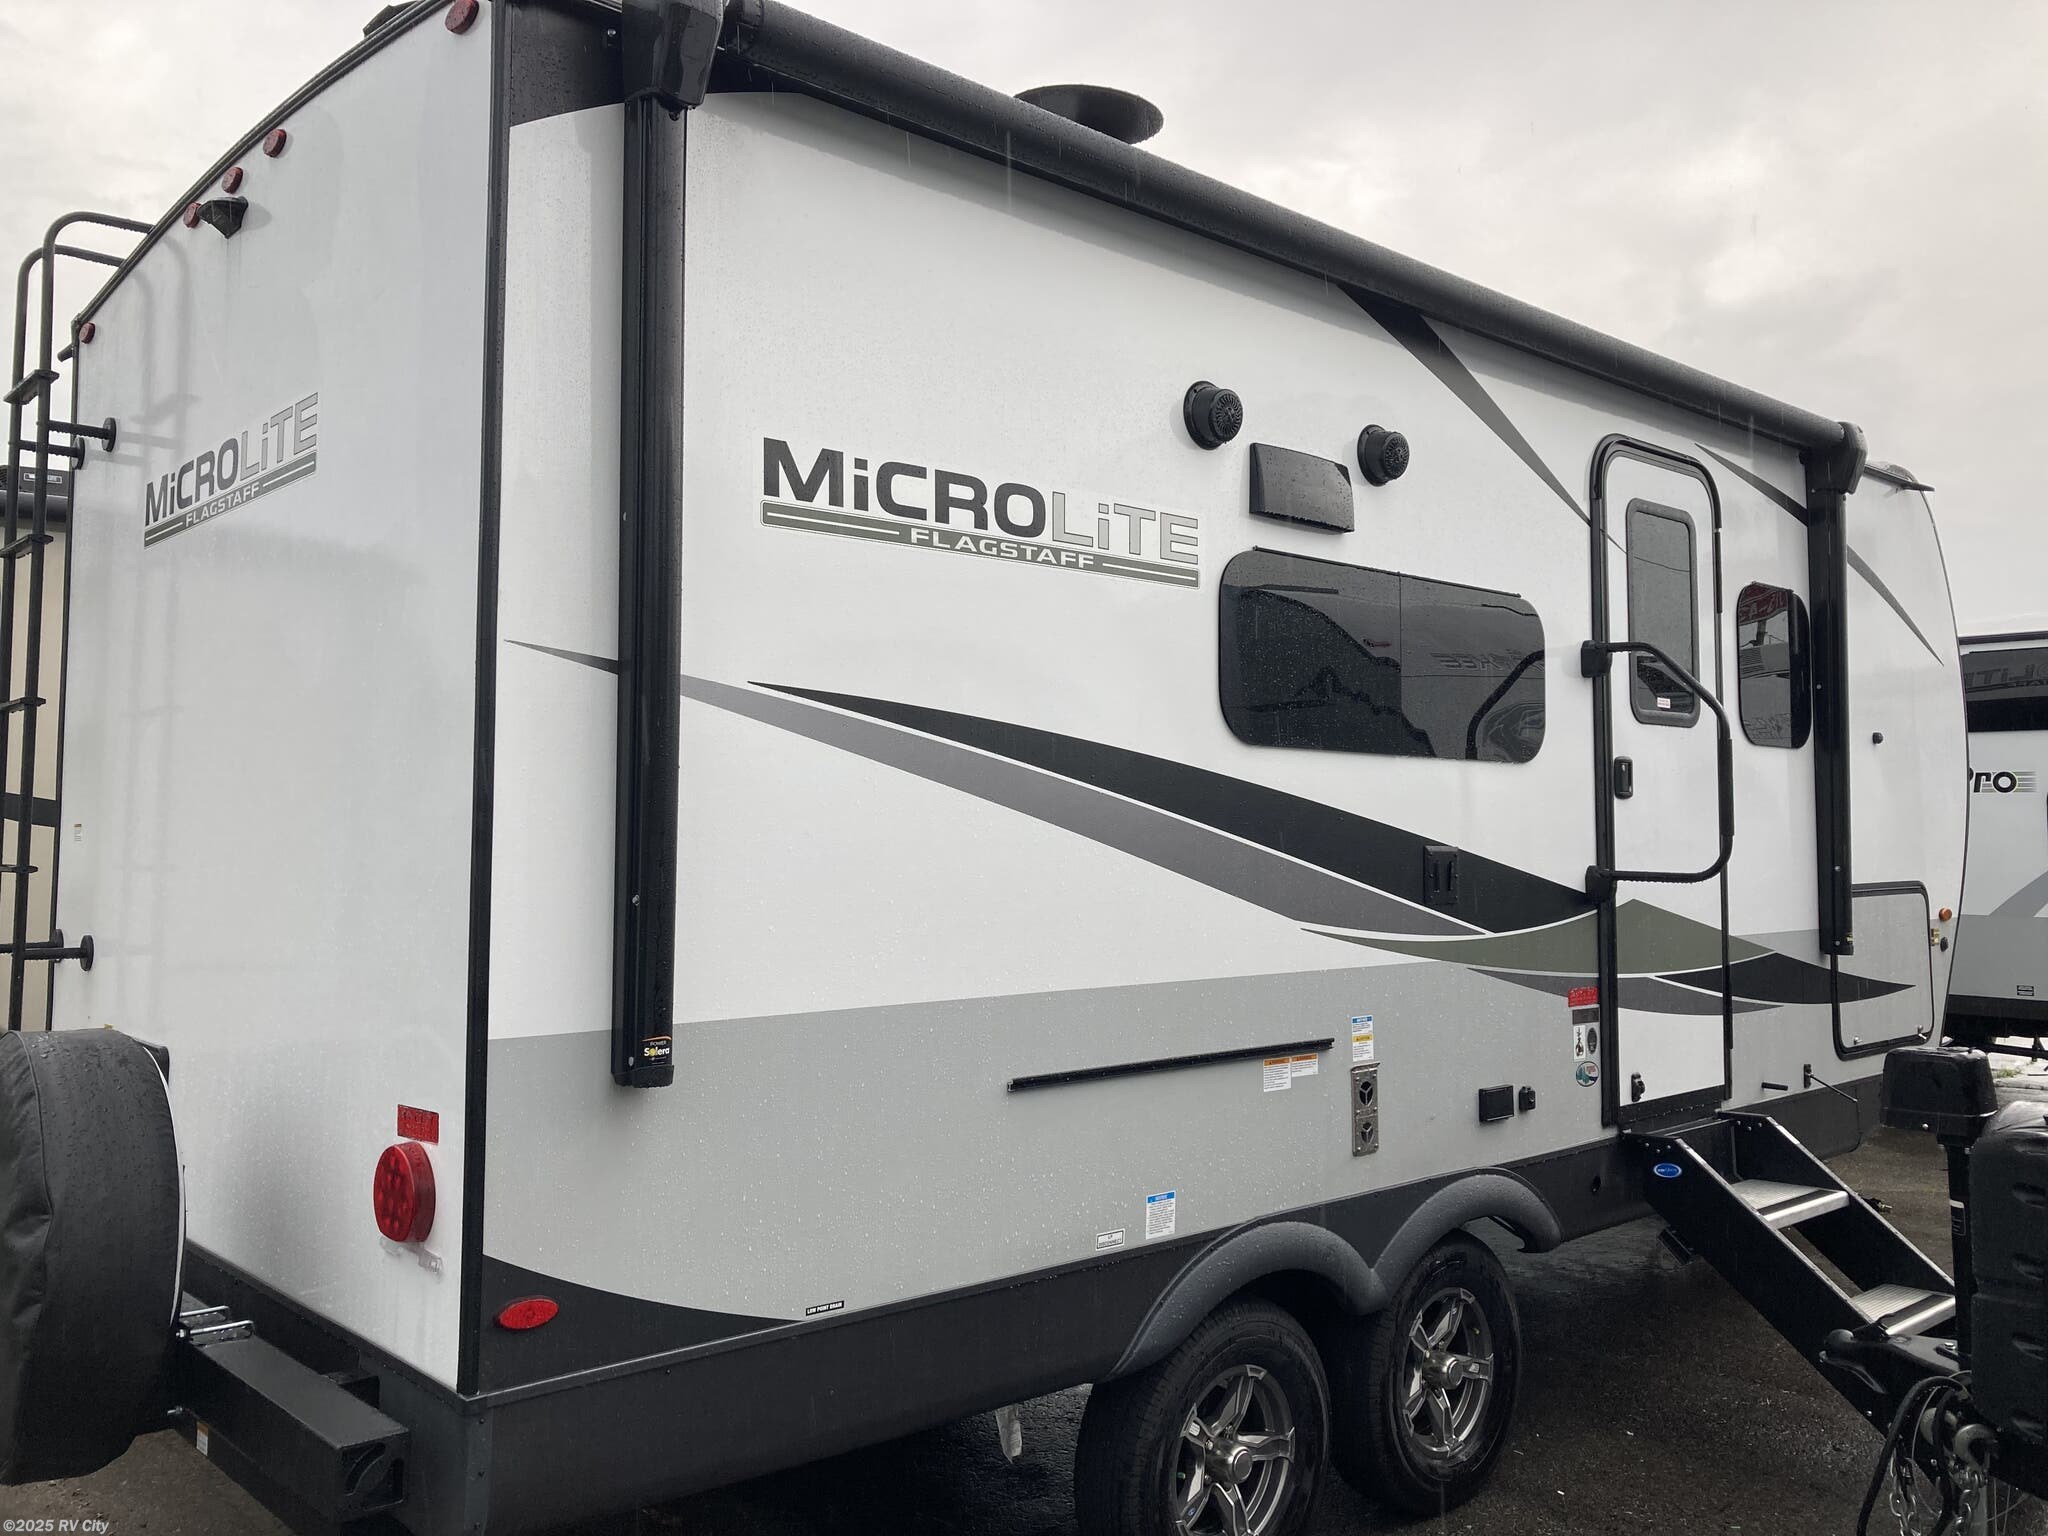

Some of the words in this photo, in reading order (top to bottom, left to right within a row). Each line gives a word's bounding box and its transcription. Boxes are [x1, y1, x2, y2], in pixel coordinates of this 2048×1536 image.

[185, 481, 260, 528] FLAGSTAFF
[910, 528, 1095, 569] FLAGSTAFF
[643, 1046, 670, 1057] Solera
